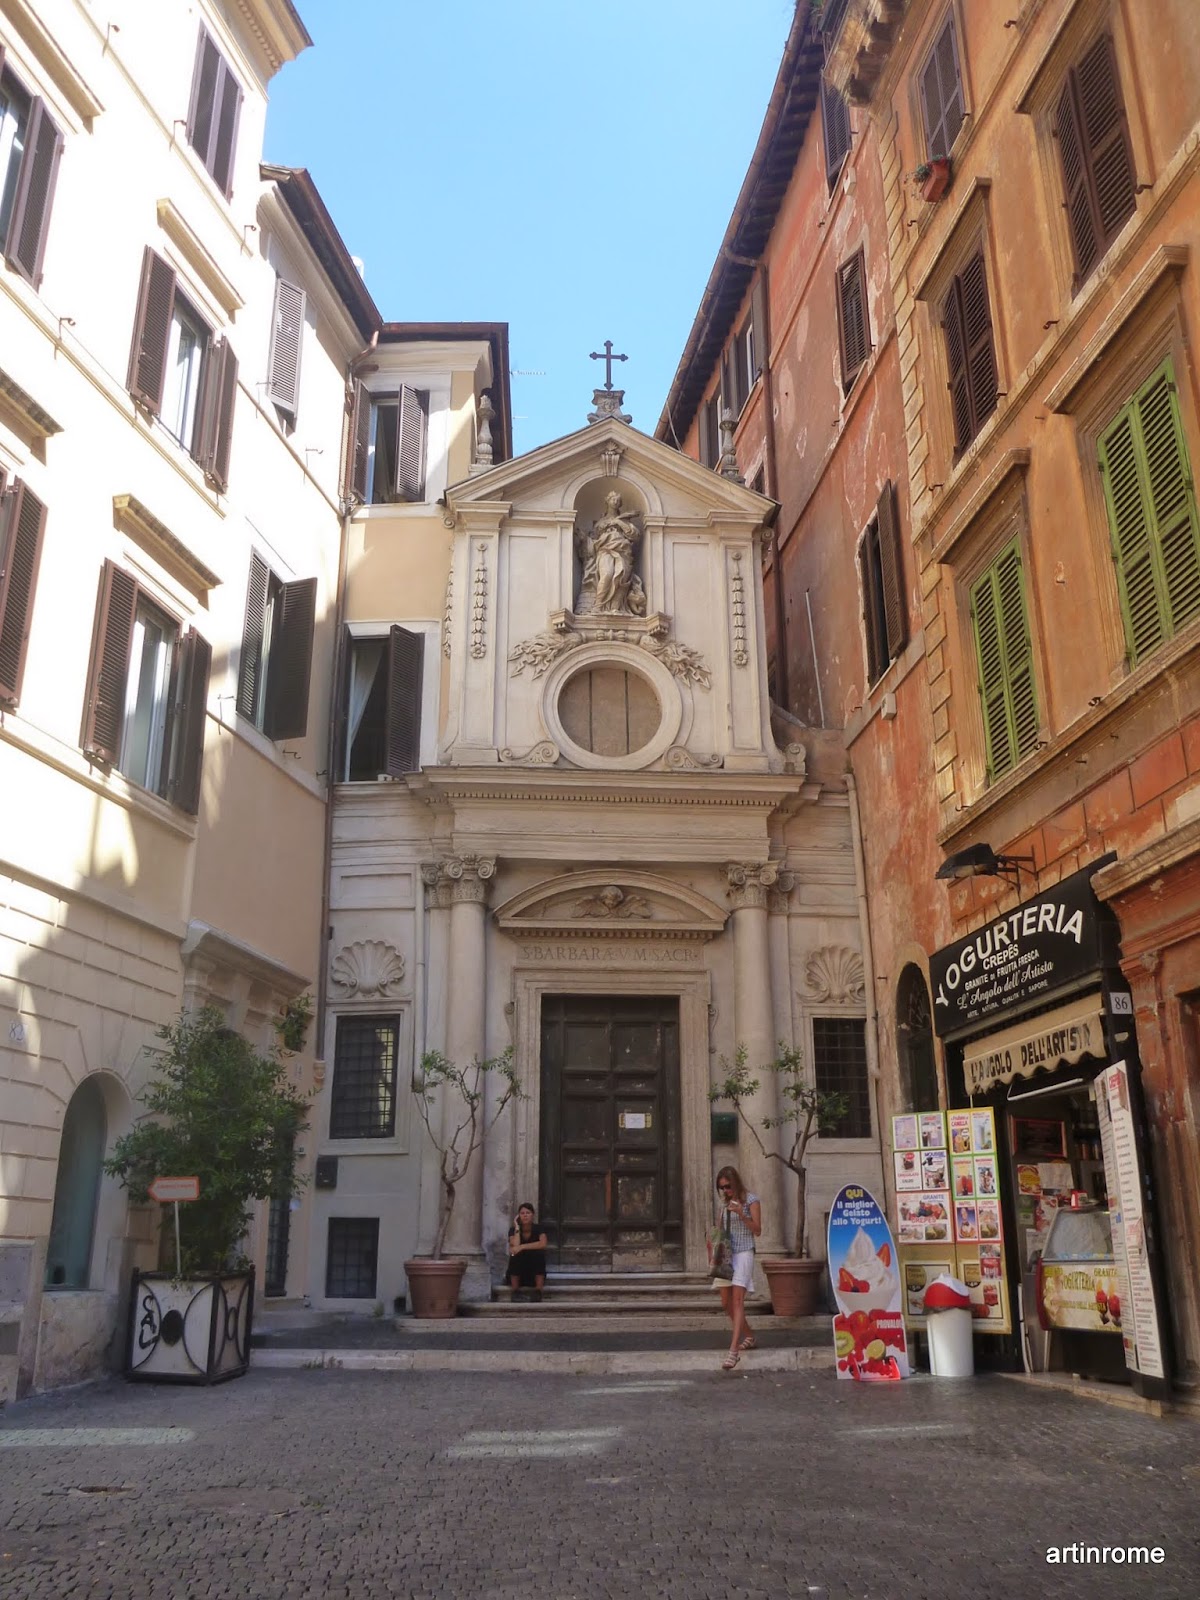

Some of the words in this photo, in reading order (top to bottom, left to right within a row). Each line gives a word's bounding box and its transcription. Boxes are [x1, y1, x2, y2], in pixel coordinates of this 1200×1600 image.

[936, 903, 1083, 1007] YOGURTERIA
[965, 973, 988, 991] GRANITE
[996, 960, 1018, 978] FRUTTA
[1018, 949, 1040, 967] FRESCA
[970, 980, 1003, 1005] Angolo
[1021, 960, 1054, 983] Artista
[1028, 979, 1048, 993] SAPORE
[1114, 996, 1128, 1010] 86
[845, 1188, 864, 1199] QUI
[844, 1200, 875, 1210] miglior
[842, 1209, 870, 1217] Gelato
[832, 1217, 848, 1226] allo
[850, 1216, 882, 1227] Yogurt!
